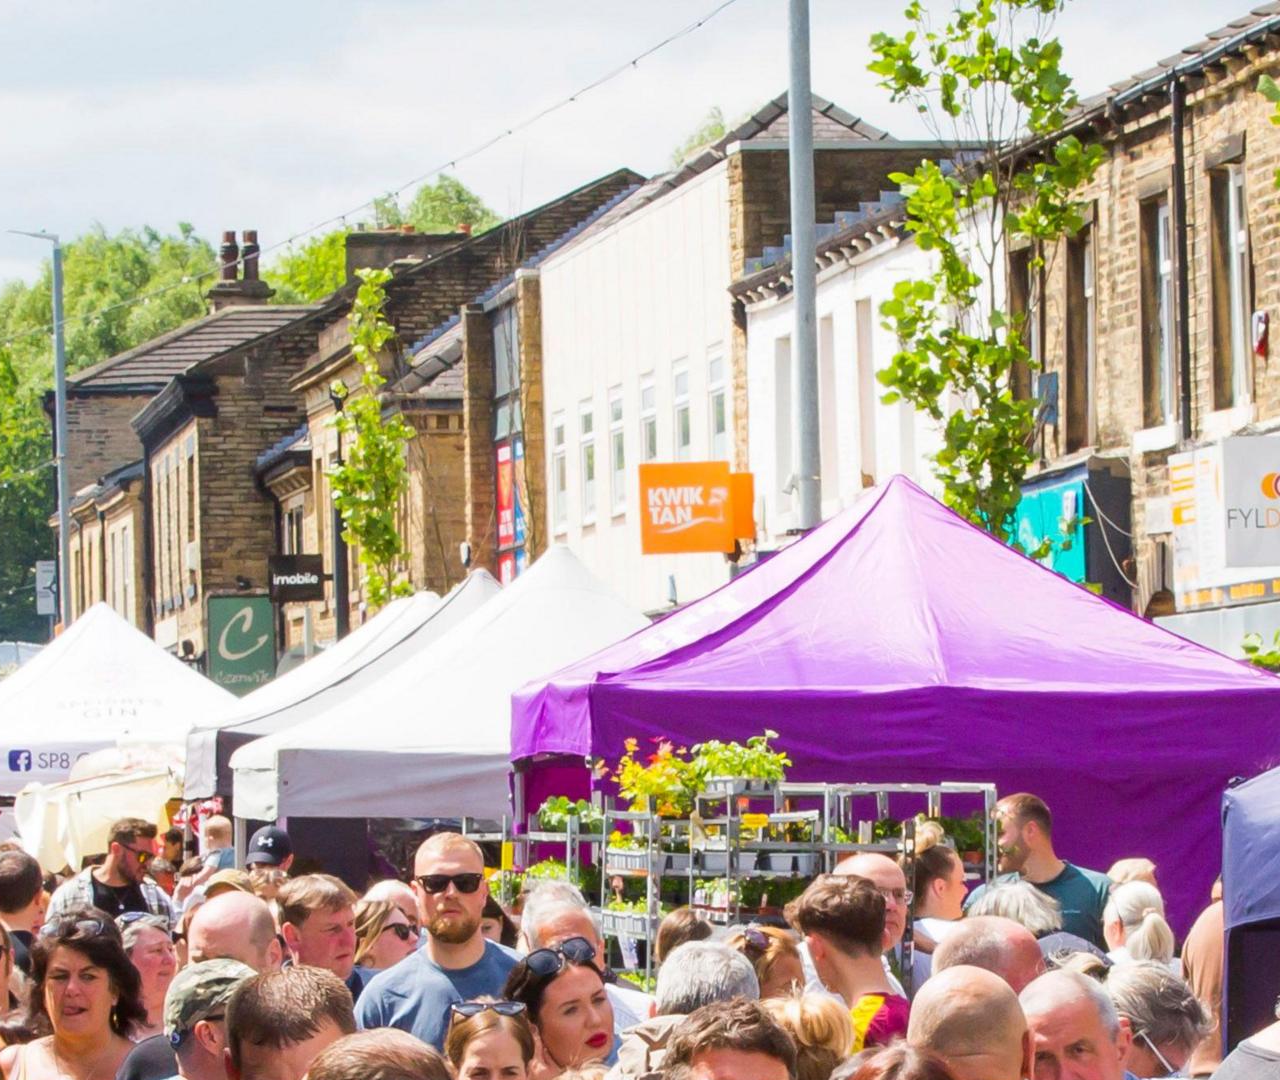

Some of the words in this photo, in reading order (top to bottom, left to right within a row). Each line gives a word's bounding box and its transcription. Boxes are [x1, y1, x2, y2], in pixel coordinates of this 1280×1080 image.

[647, 486, 704, 507] KWIK
[650, 506, 693, 525] TAN
[37, 752, 70, 770] SP8
